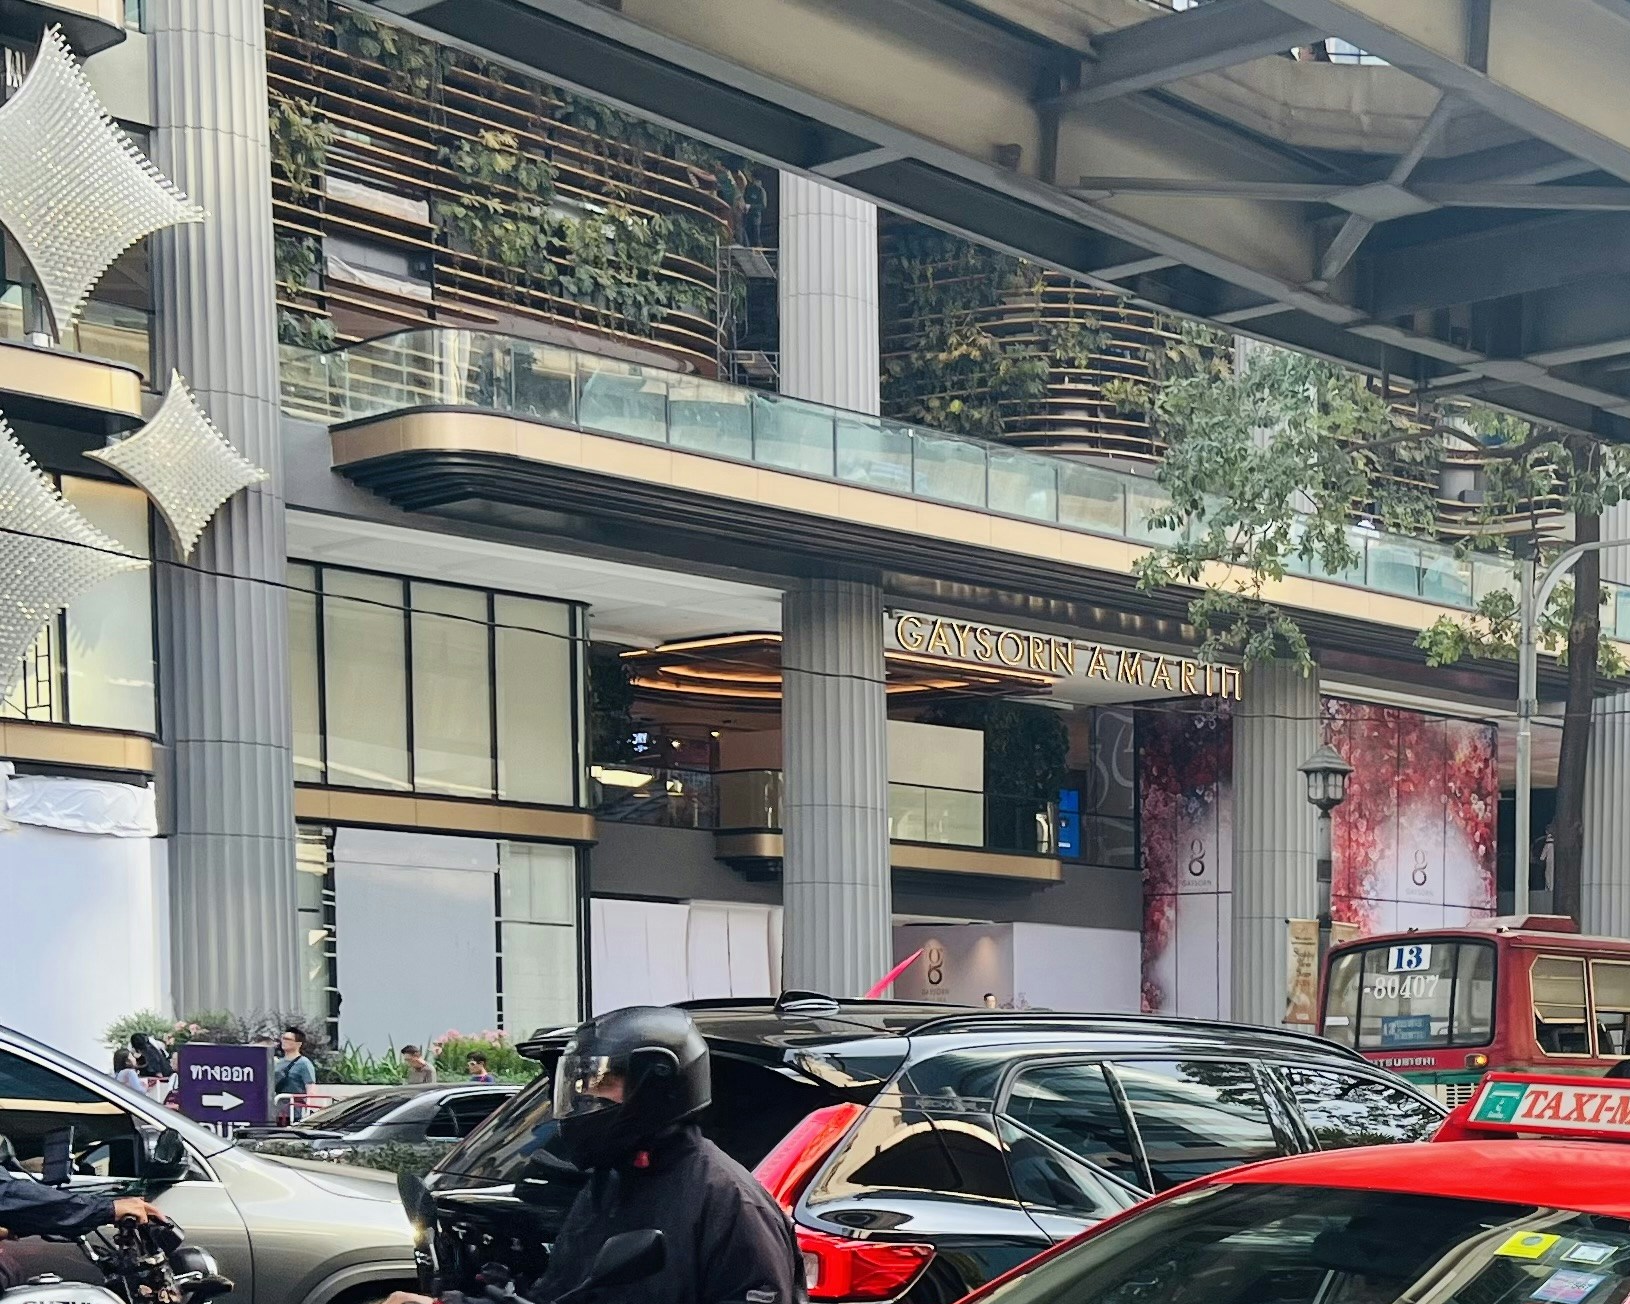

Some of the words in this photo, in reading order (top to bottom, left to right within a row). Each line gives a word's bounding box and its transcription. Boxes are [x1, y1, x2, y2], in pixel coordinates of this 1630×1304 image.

[896, 614, 1076, 676] GAYSORN
[1394, 946, 1423, 970] 13
[190, 1064, 254, 1082] ทางออก
